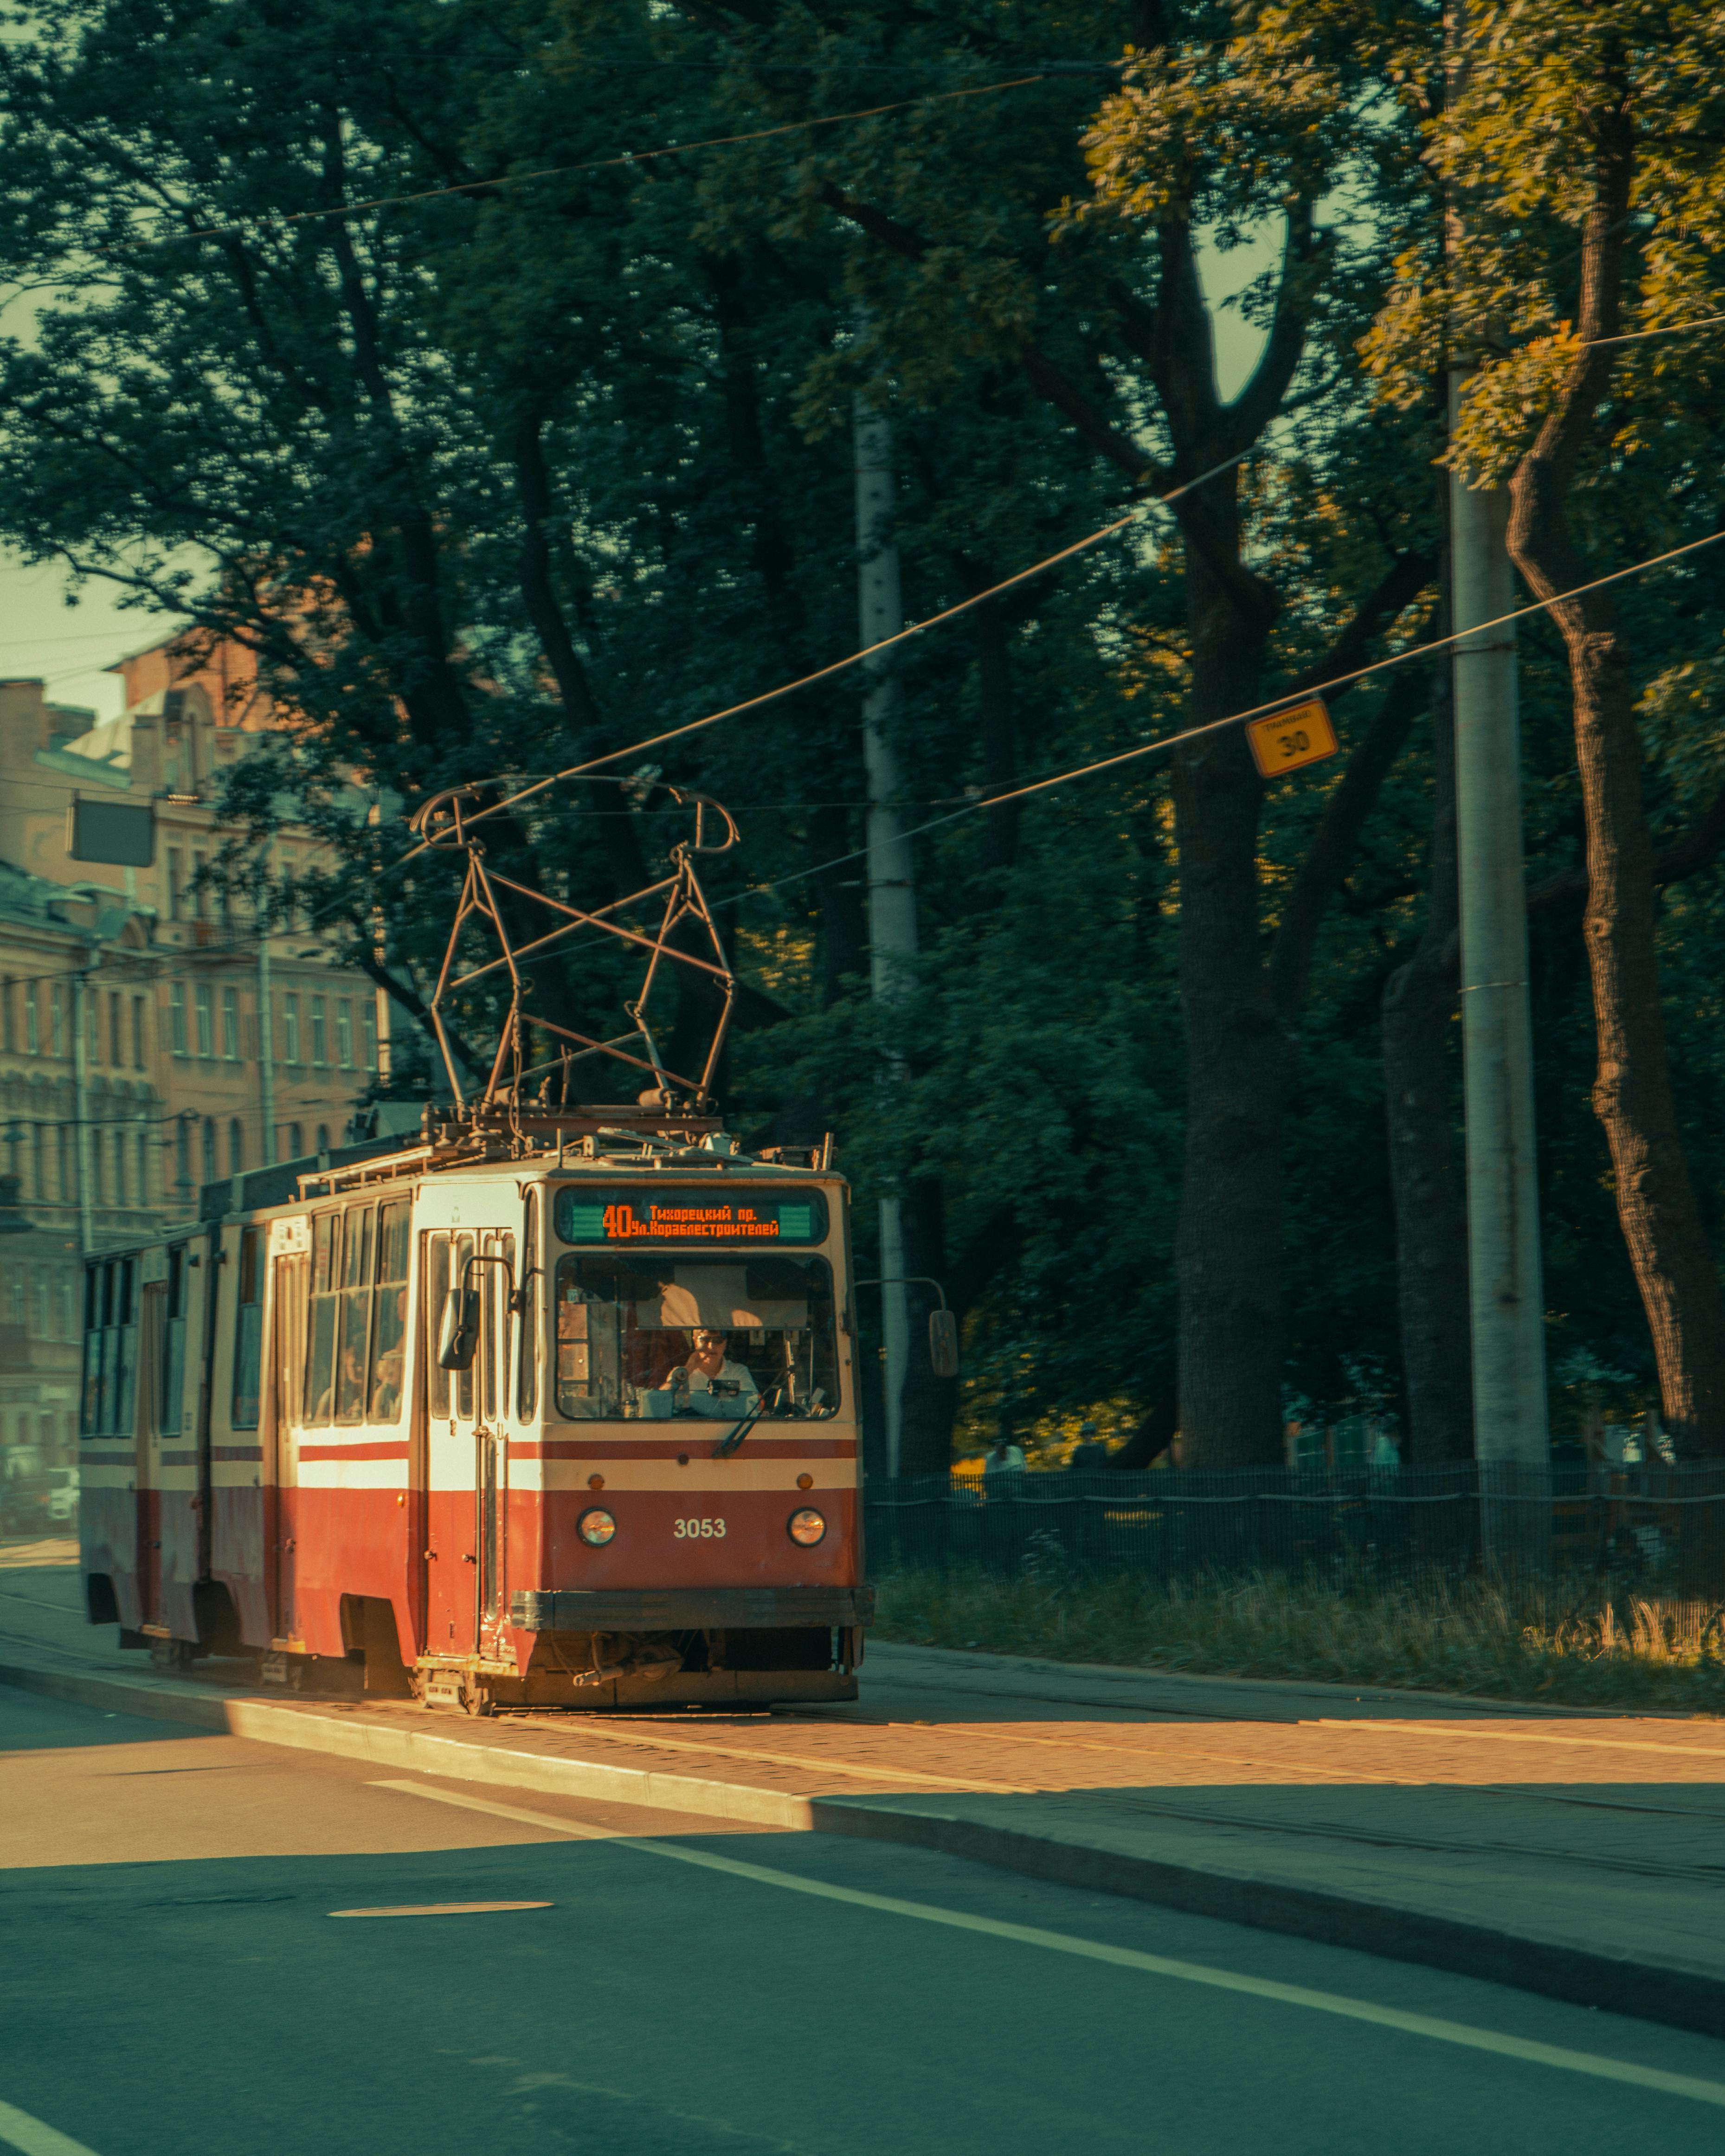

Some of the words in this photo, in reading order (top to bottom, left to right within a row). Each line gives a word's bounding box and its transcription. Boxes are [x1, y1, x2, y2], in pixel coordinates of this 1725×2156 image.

[1277, 730, 1310, 757] 30
[603, 1205, 632, 1237] 40
[650, 1205, 731, 1222] Тихорецкий
[738, 1209, 757, 1222] пр.
[673, 1518, 726, 1538] 3053
